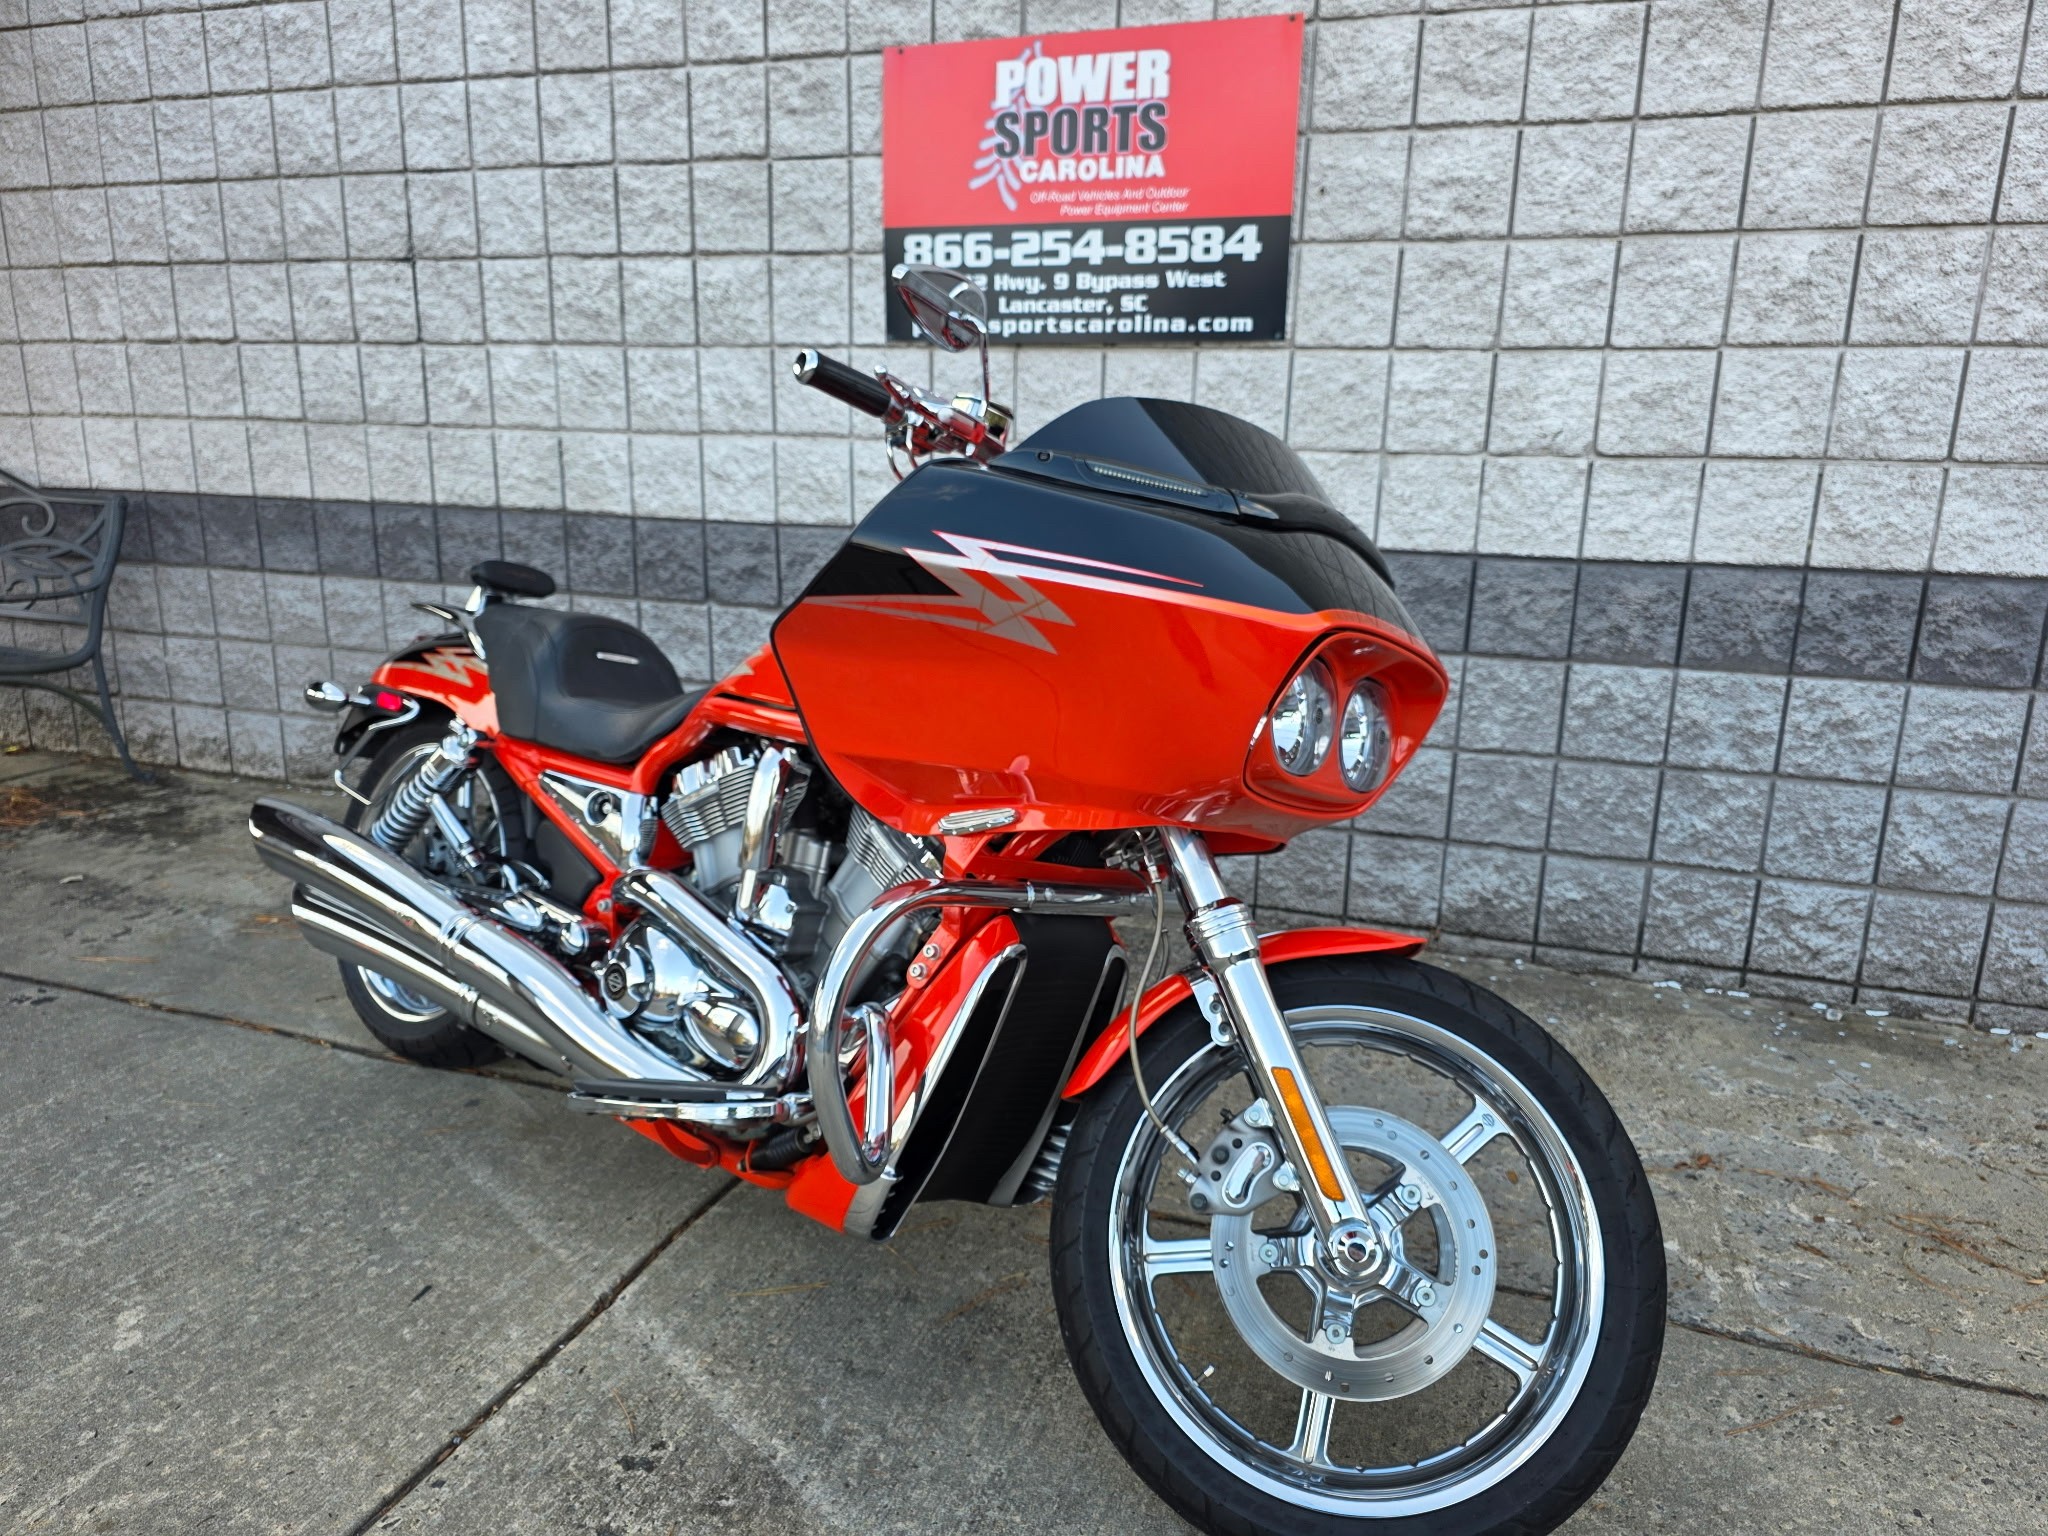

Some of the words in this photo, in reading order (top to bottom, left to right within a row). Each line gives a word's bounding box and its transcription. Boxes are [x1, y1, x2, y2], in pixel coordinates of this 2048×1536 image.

[995, 49, 1171, 108] POWER
[994, 101, 1167, 159] SPORTS
[1019, 154, 1166, 184] CAROLINA
[1030, 189, 1075, 204] Off-Road
[1078, 188, 1120, 202] Vehicles
[1122, 187, 1145, 200] And
[1145, 186, 1190, 199] Outdoor
[1060, 204, 1094, 216] Power
[1094, 202, 1150, 217] Equipment
[1151, 200, 1189, 214] Center
[903, 223, 1263, 268] 866-254-8584
[993, 273, 1047, 294] Hwy.
[1053, 272, 1070, 291] 9
[1076, 271, 1160, 293] Bypass
[1165, 269, 1227, 288] West
[998, 295, 1114, 315] Lancaster,
[1120, 294, 1149, 312] SC
[911, 314, 1254, 338] sportscarolina.com
